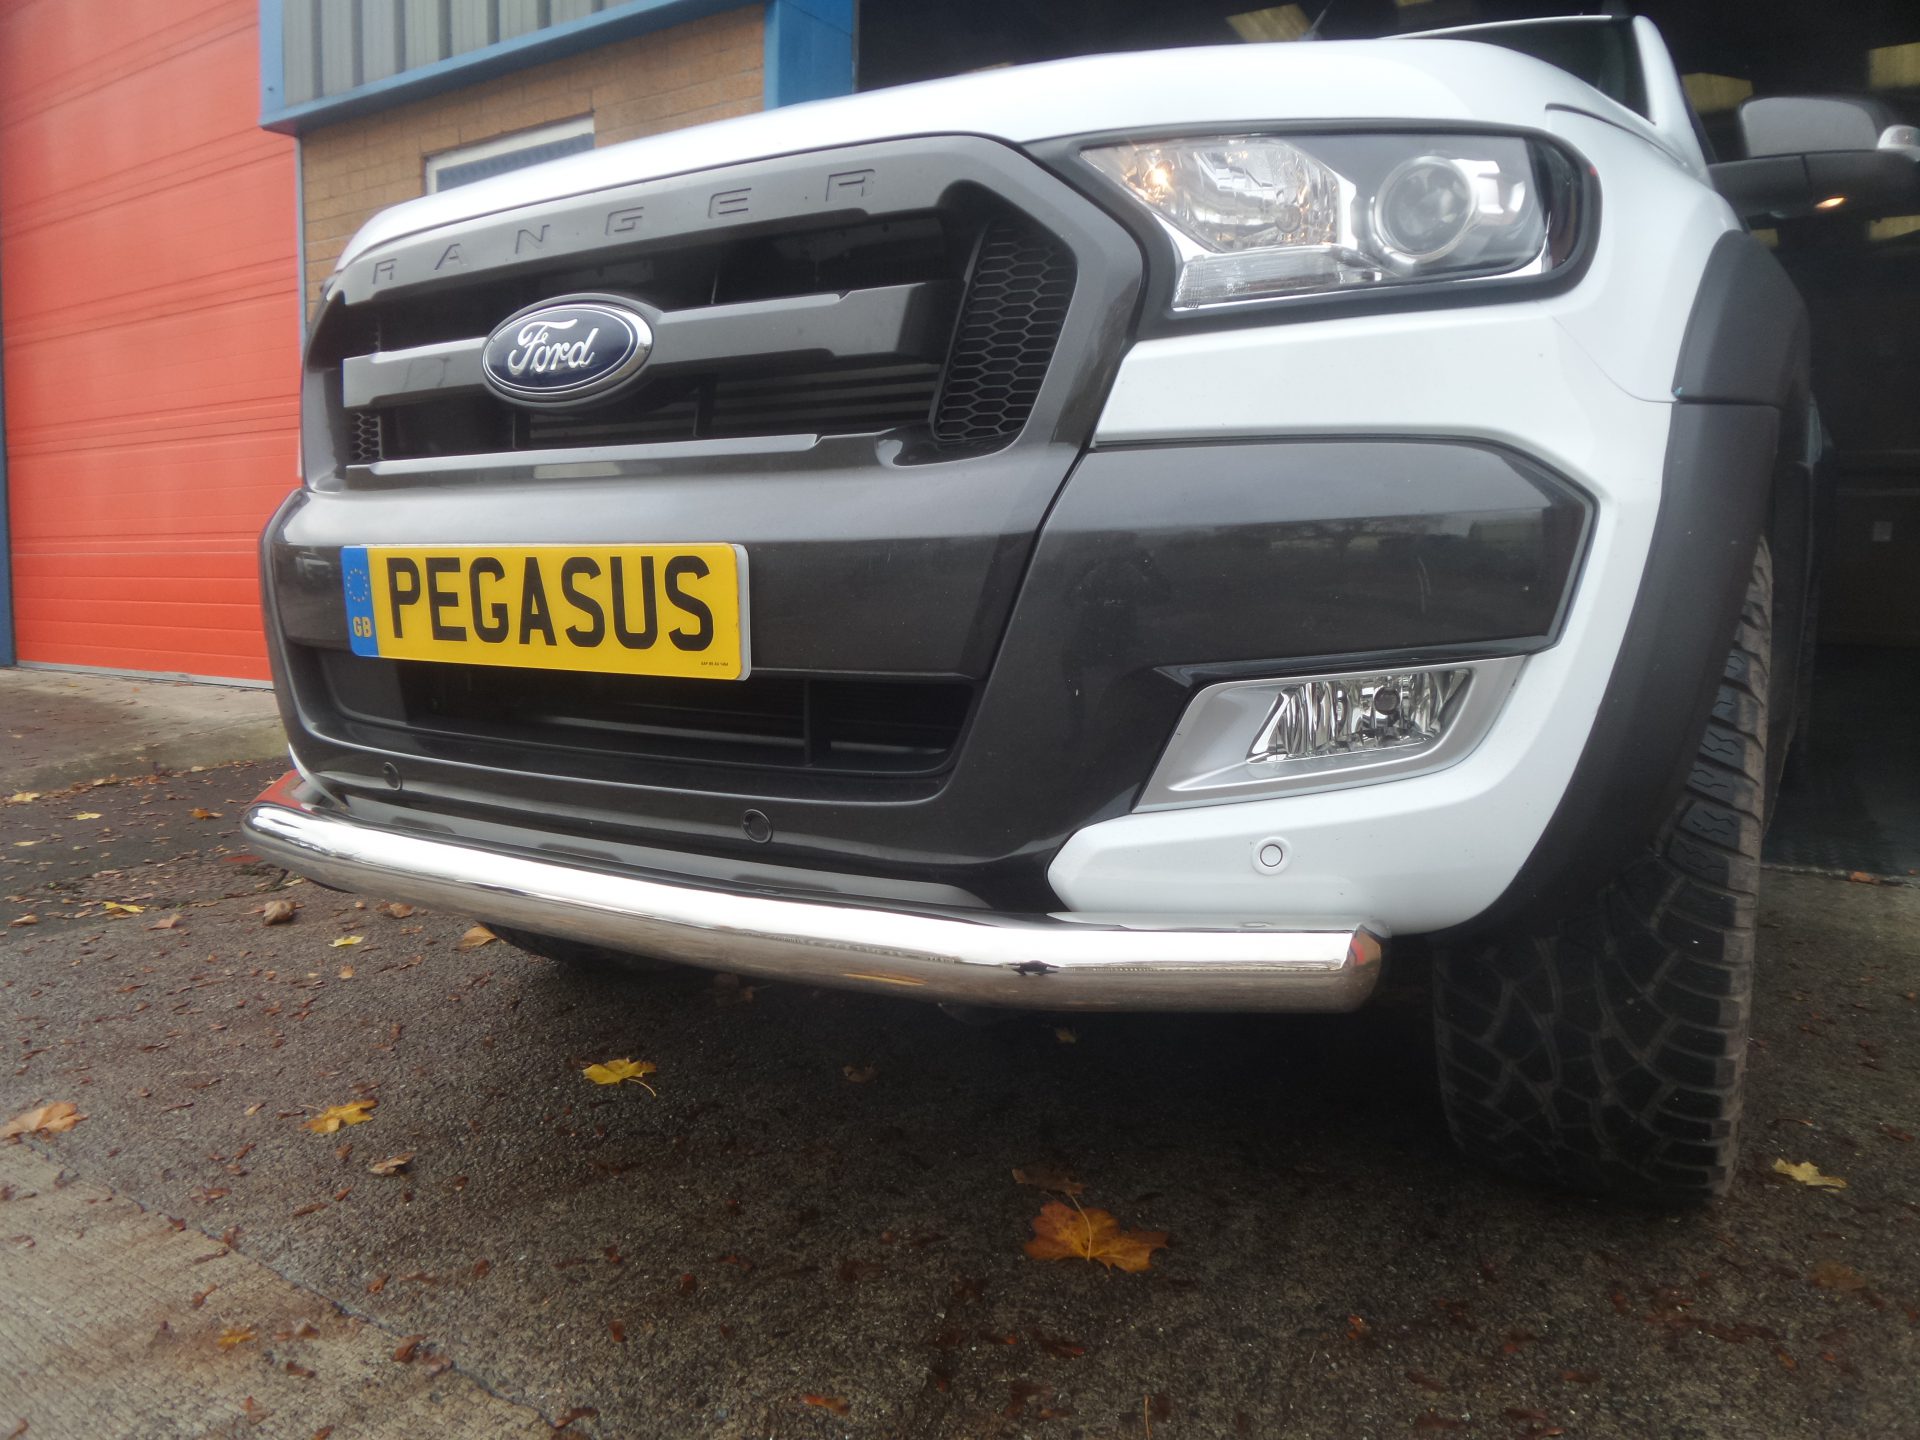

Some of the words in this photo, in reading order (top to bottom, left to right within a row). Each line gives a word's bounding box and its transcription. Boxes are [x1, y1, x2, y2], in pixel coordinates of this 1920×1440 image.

[372, 168, 876, 285] RANGER
[507, 318, 599, 376] Ford
[353, 616, 372, 638] GB
[385, 555, 714, 652] PEGASUS
